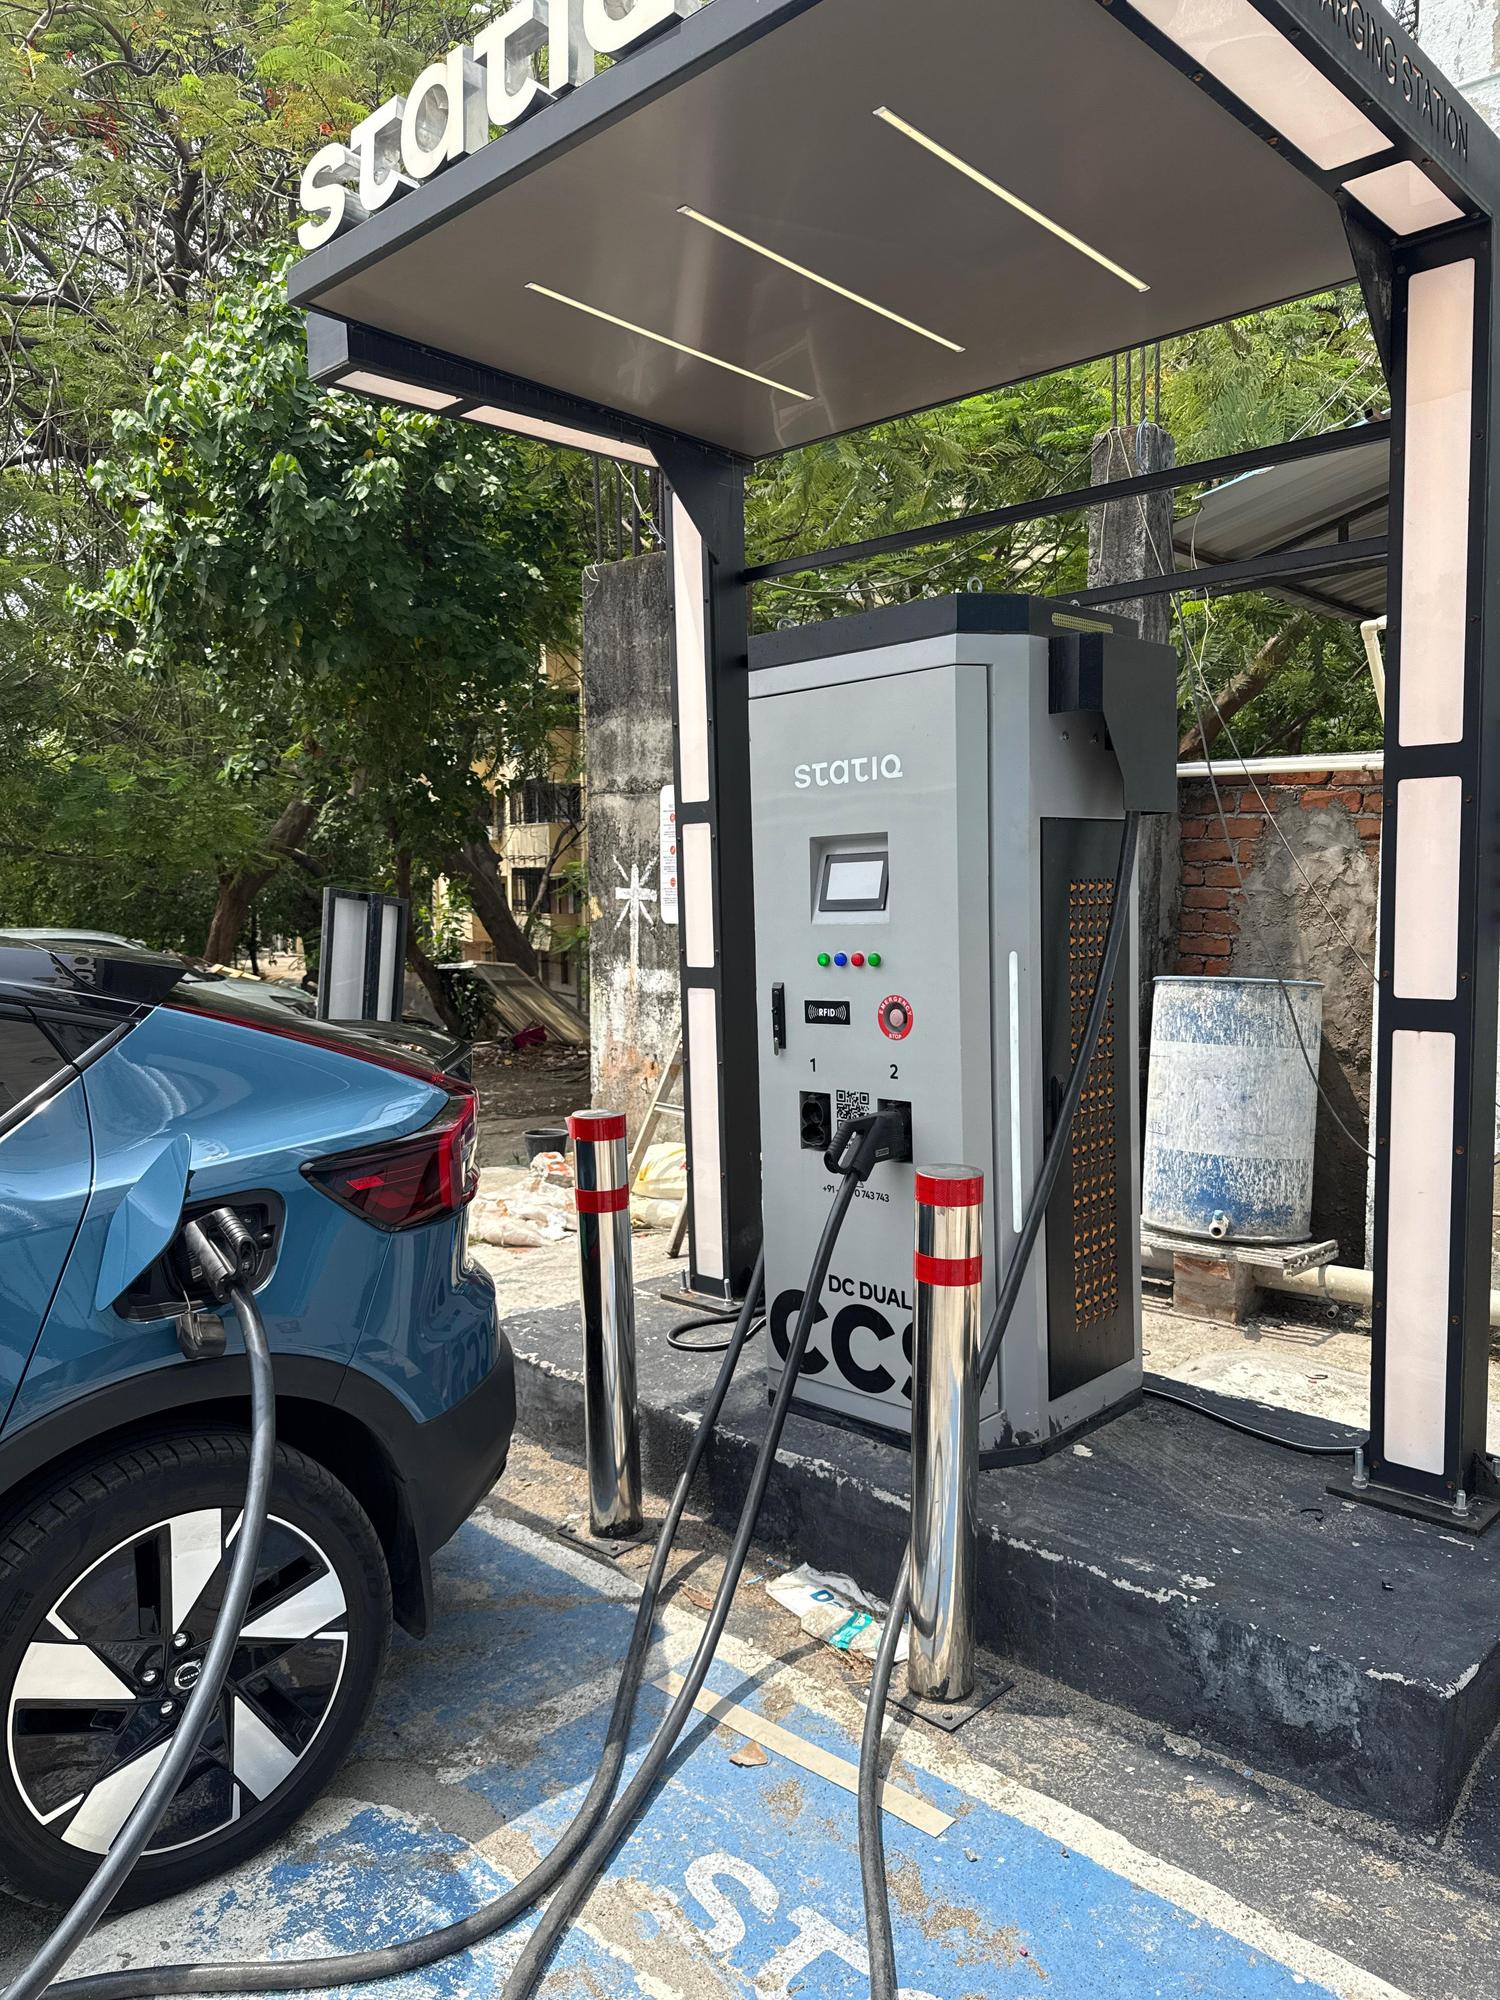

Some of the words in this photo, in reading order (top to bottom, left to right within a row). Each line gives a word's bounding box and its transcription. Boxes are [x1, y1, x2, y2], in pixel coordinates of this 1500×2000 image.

[1402, 54, 1468, 163] STATION
[818, 1008, 836, 1017] RFID
[879, 996, 912, 1016] EMERGENCY
[809, 1057, 816, 1073] 1
[889, 1063, 899, 1080] 2
[875, 1192, 890, 1203] 743
[828, 1273, 855, 1297] DC
[859, 1281, 913, 1311] DUAL
[769, 1288, 913, 1402] CC
